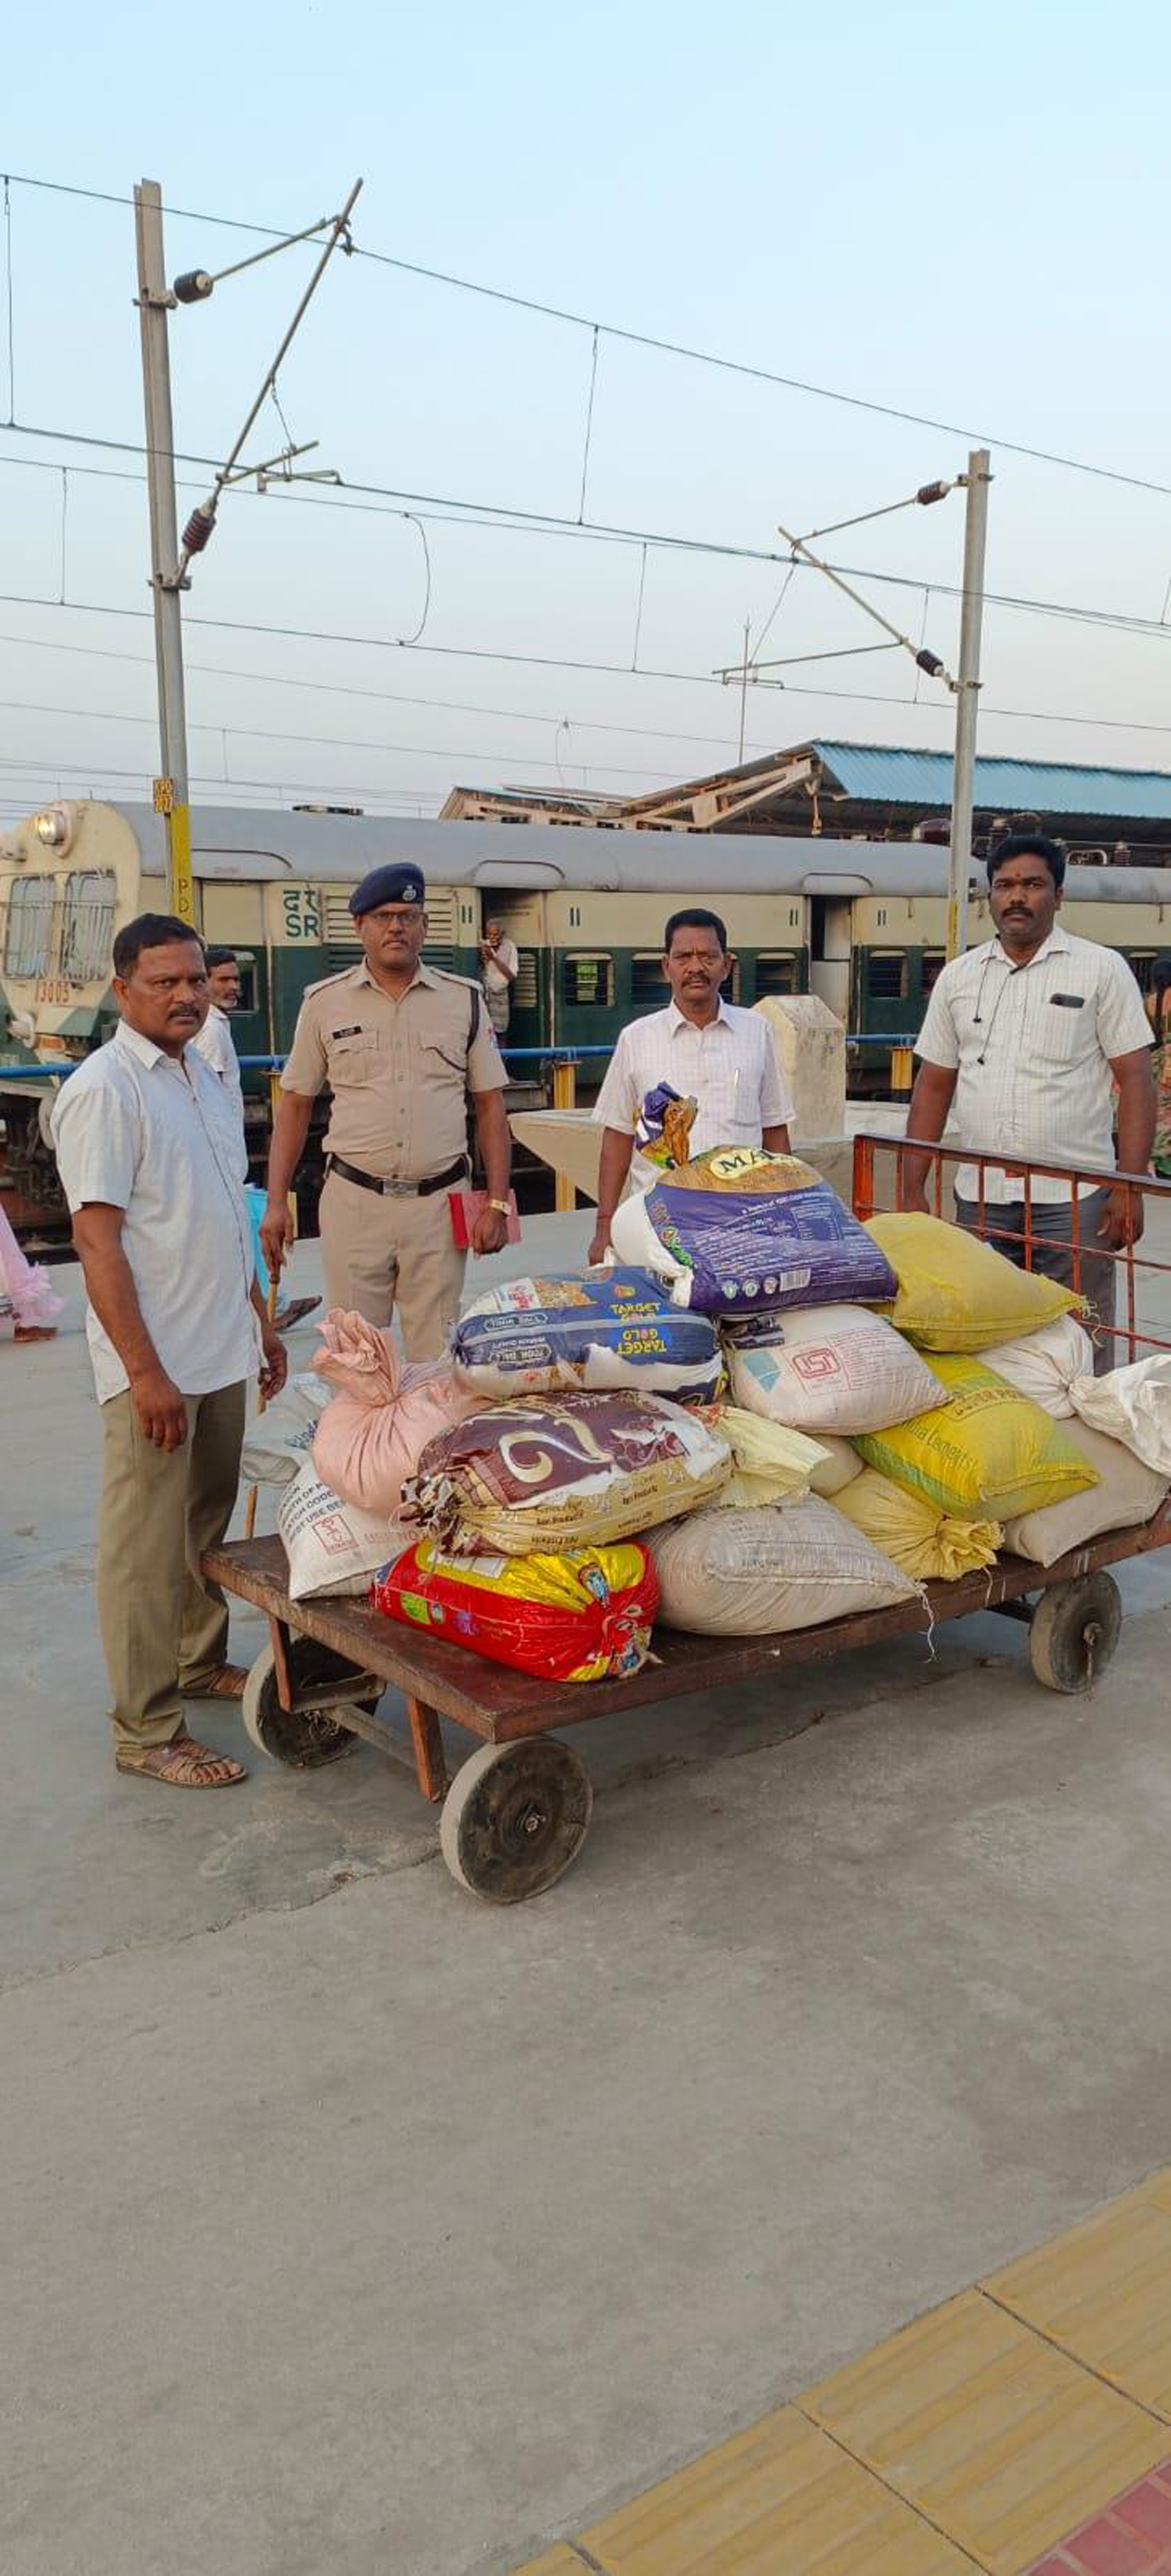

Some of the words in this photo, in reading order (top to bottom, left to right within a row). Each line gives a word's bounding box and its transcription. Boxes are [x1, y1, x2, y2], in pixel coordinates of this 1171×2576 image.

[286, 915, 319, 937] SR
[610, 1302, 660, 1315] TARGET
[623, 1327, 658, 1341] GOLD
[618, 1339, 667, 1354] TARGET
